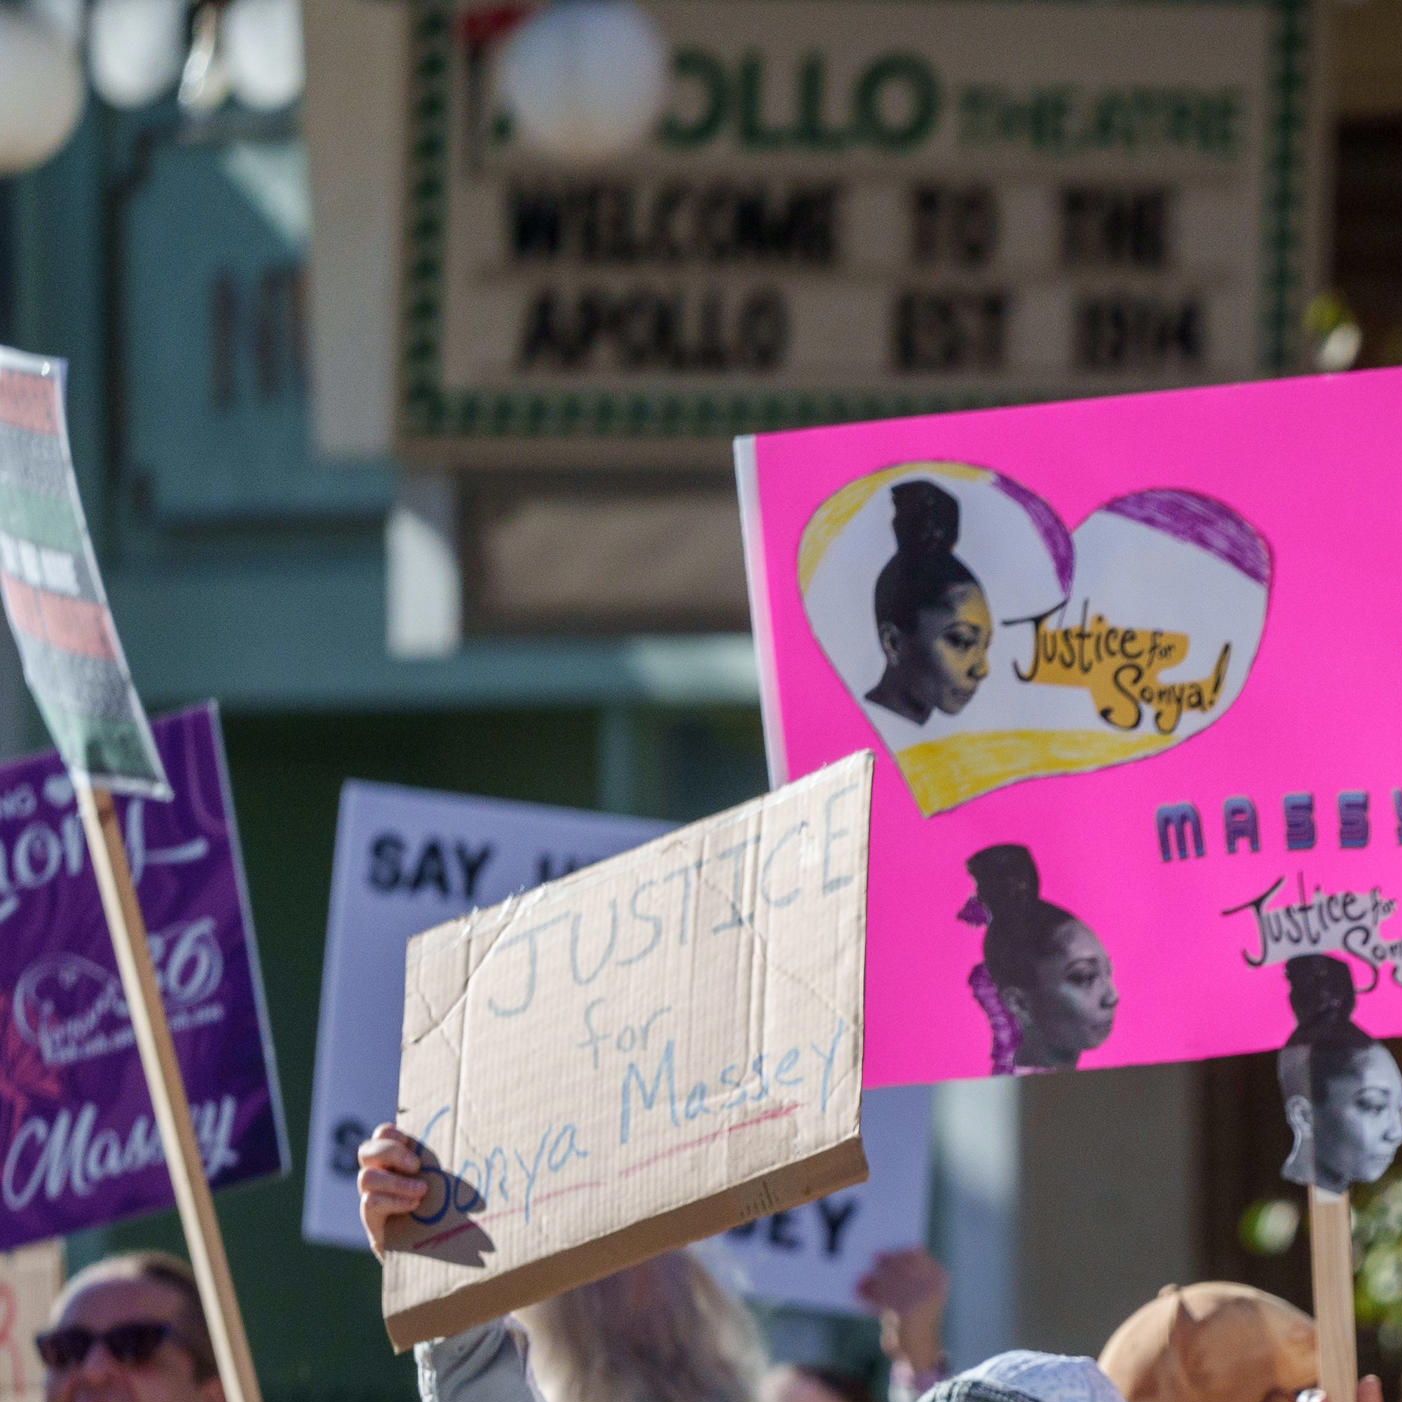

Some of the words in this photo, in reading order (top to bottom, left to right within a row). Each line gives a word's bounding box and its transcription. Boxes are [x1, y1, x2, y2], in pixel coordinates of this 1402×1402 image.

[522, 288, 790, 370] APOLLO
[1001, 597, 1144, 683] Justice
[1099, 640, 1232, 735] Sonya!
[366, 833, 494, 898] SAY
[488, 784, 860, 1018] JUSTICE
[1221, 870, 1366, 968] Justice
[577, 997, 672, 1069] for
[410, 1105, 589, 1225] Sonya
